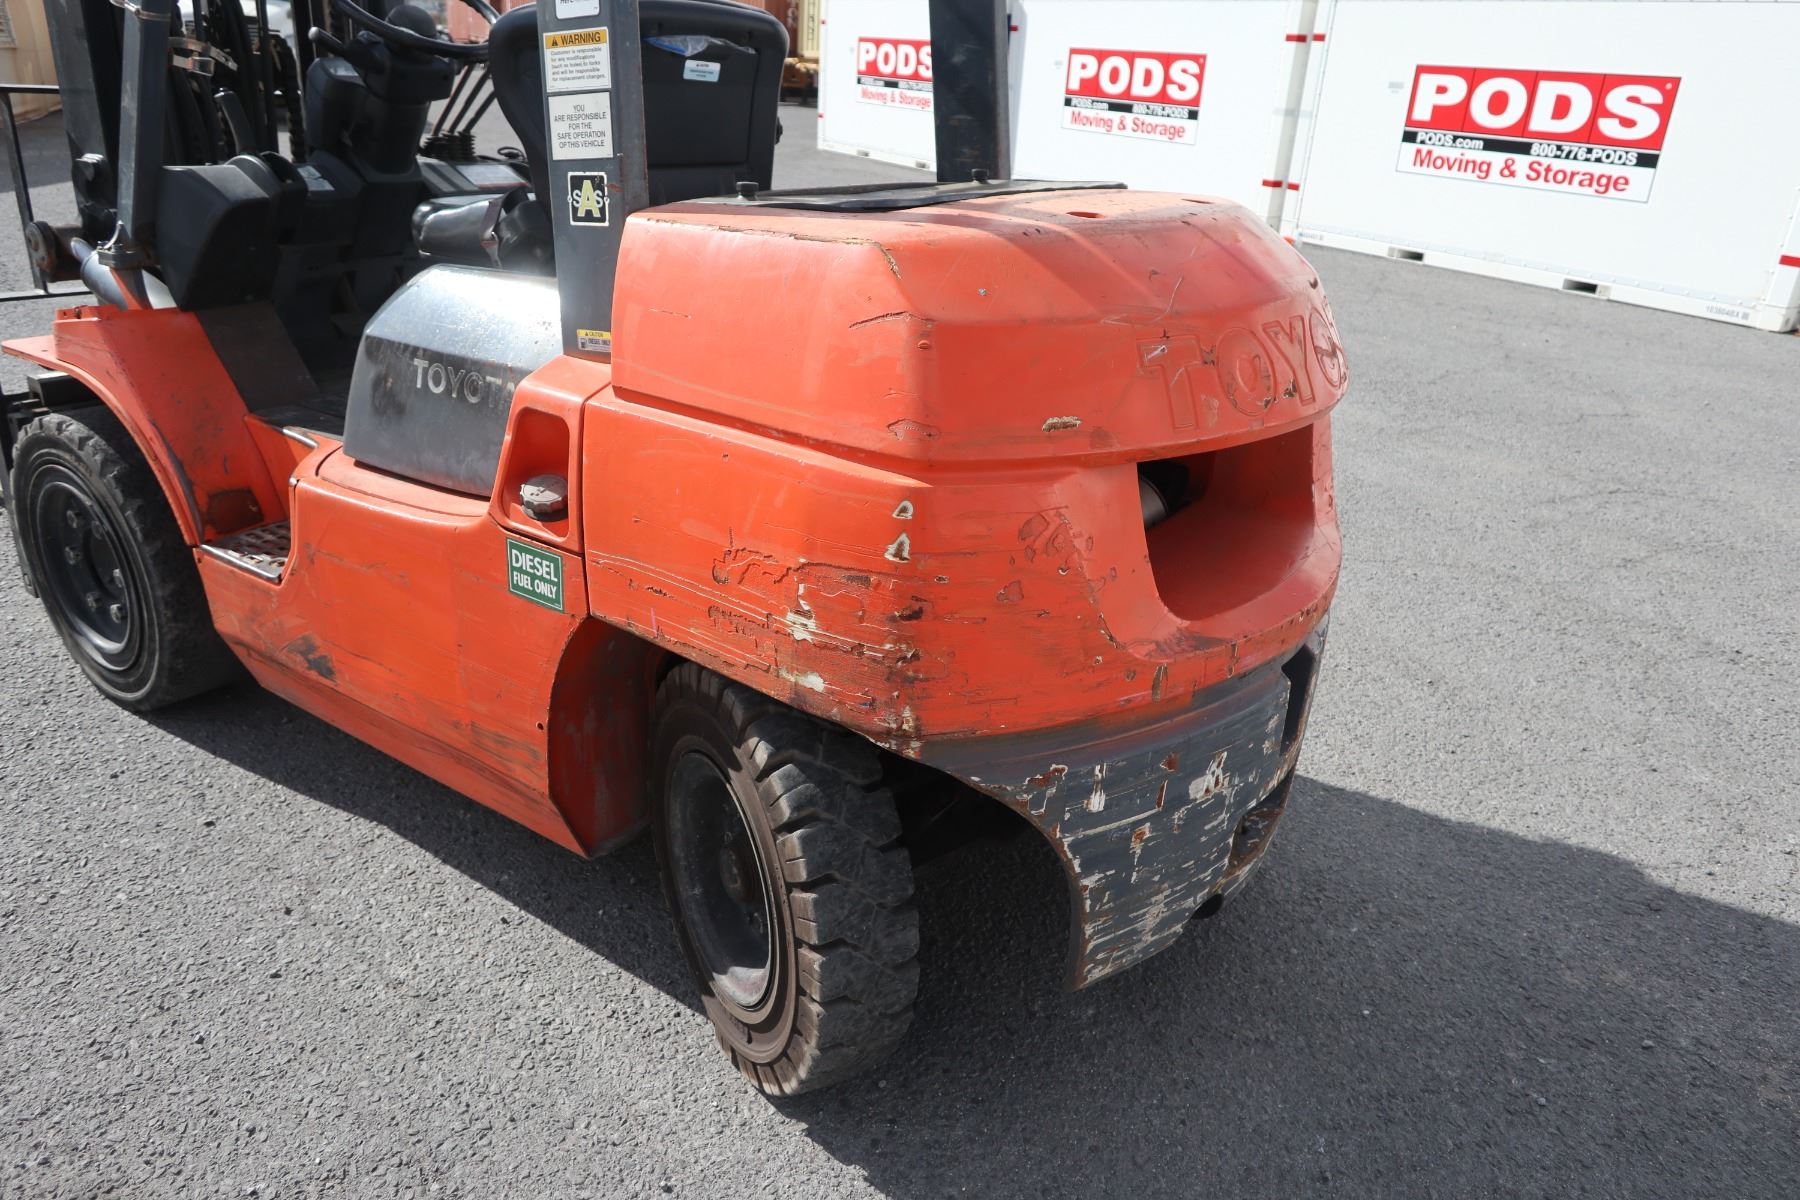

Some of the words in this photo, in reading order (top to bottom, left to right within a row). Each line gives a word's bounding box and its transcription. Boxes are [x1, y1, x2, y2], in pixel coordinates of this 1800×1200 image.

[560, 32, 601, 45] WARNING
[859, 41, 932, 78] PODS
[1068, 53, 1201, 102] PODS
[554, 114, 566, 122] ARE
[566, 111, 607, 121] RESPONSIBLE
[573, 104, 585, 112] YOU
[1411, 73, 1664, 140] PODS
[557, 132, 572, 140] SAFE
[572, 130, 606, 139] OPERATION
[568, 122, 580, 131] FOR
[580, 122, 592, 130] THE
[1070, 110, 1113, 133] Moving
[1117, 115, 1127, 131] &
[1131, 117, 1186, 140] Storage
[567, 140, 580, 148] THIS
[580, 139, 605, 148] VEHICLE
[1415, 131, 1484, 150] PODS.com
[1529, 142, 1639, 167] 800-776-PODS
[1412, 147, 1492, 180] Moving
[1499, 157, 1518, 179] &
[1525, 160, 1631, 195] Storage
[414, 358, 515, 408] TOYOT
[511, 548, 558, 582] DIESEL
[513, 571, 533, 591] FUEL
[534, 579, 557, 599] ONLY
